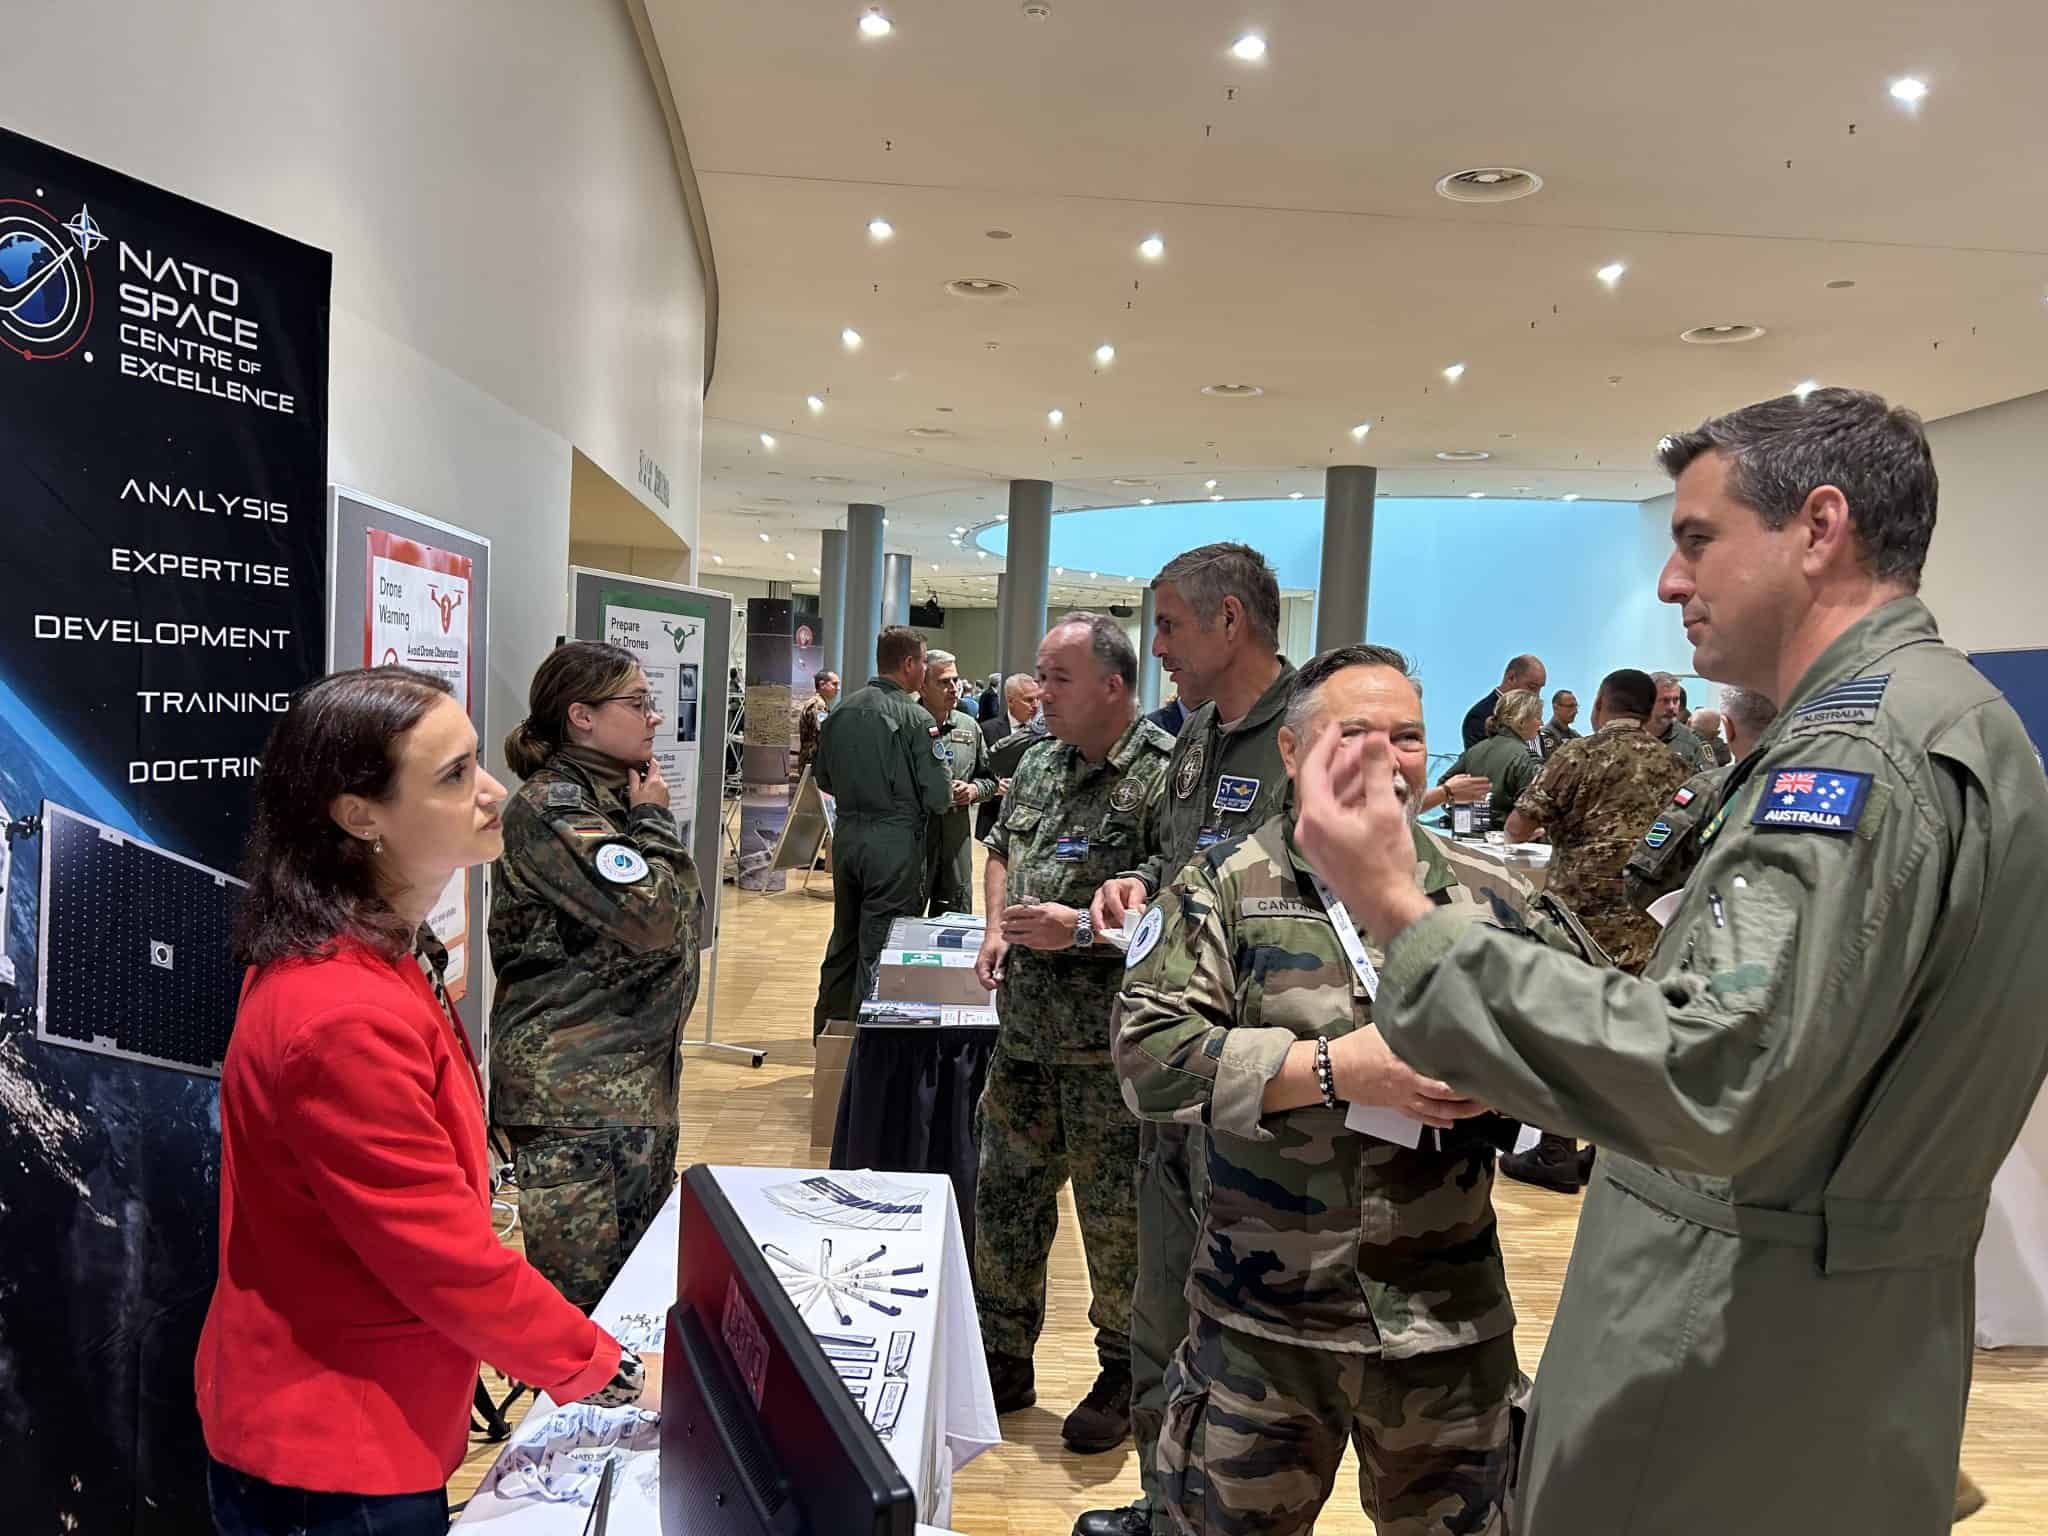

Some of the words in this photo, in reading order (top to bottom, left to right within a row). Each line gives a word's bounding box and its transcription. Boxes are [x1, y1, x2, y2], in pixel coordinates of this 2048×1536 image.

[119, 240, 239, 307] NATO
[119, 282, 259, 350] SPACE
[119, 323, 233, 371] CENTRE
[238, 358, 262, 375] OF
[120, 353, 294, 414] EXCELLENCE
[120, 478, 289, 524] ANALYSIS
[111, 548, 290, 587] EXPERTISE
[380, 576, 402, 599] Drone
[379, 604, 410, 631] Warning
[611, 616, 640, 633] Prepare
[34, 614, 291, 650] DEVELOPMENT
[623, 636, 649, 650] Drones
[136, 691, 290, 713] TRAINING
[1803, 709, 1865, 722] AUSTRALIA
[129, 756, 263, 784] DOCTRIN
[1764, 809, 1841, 826] AUSTRALIA
